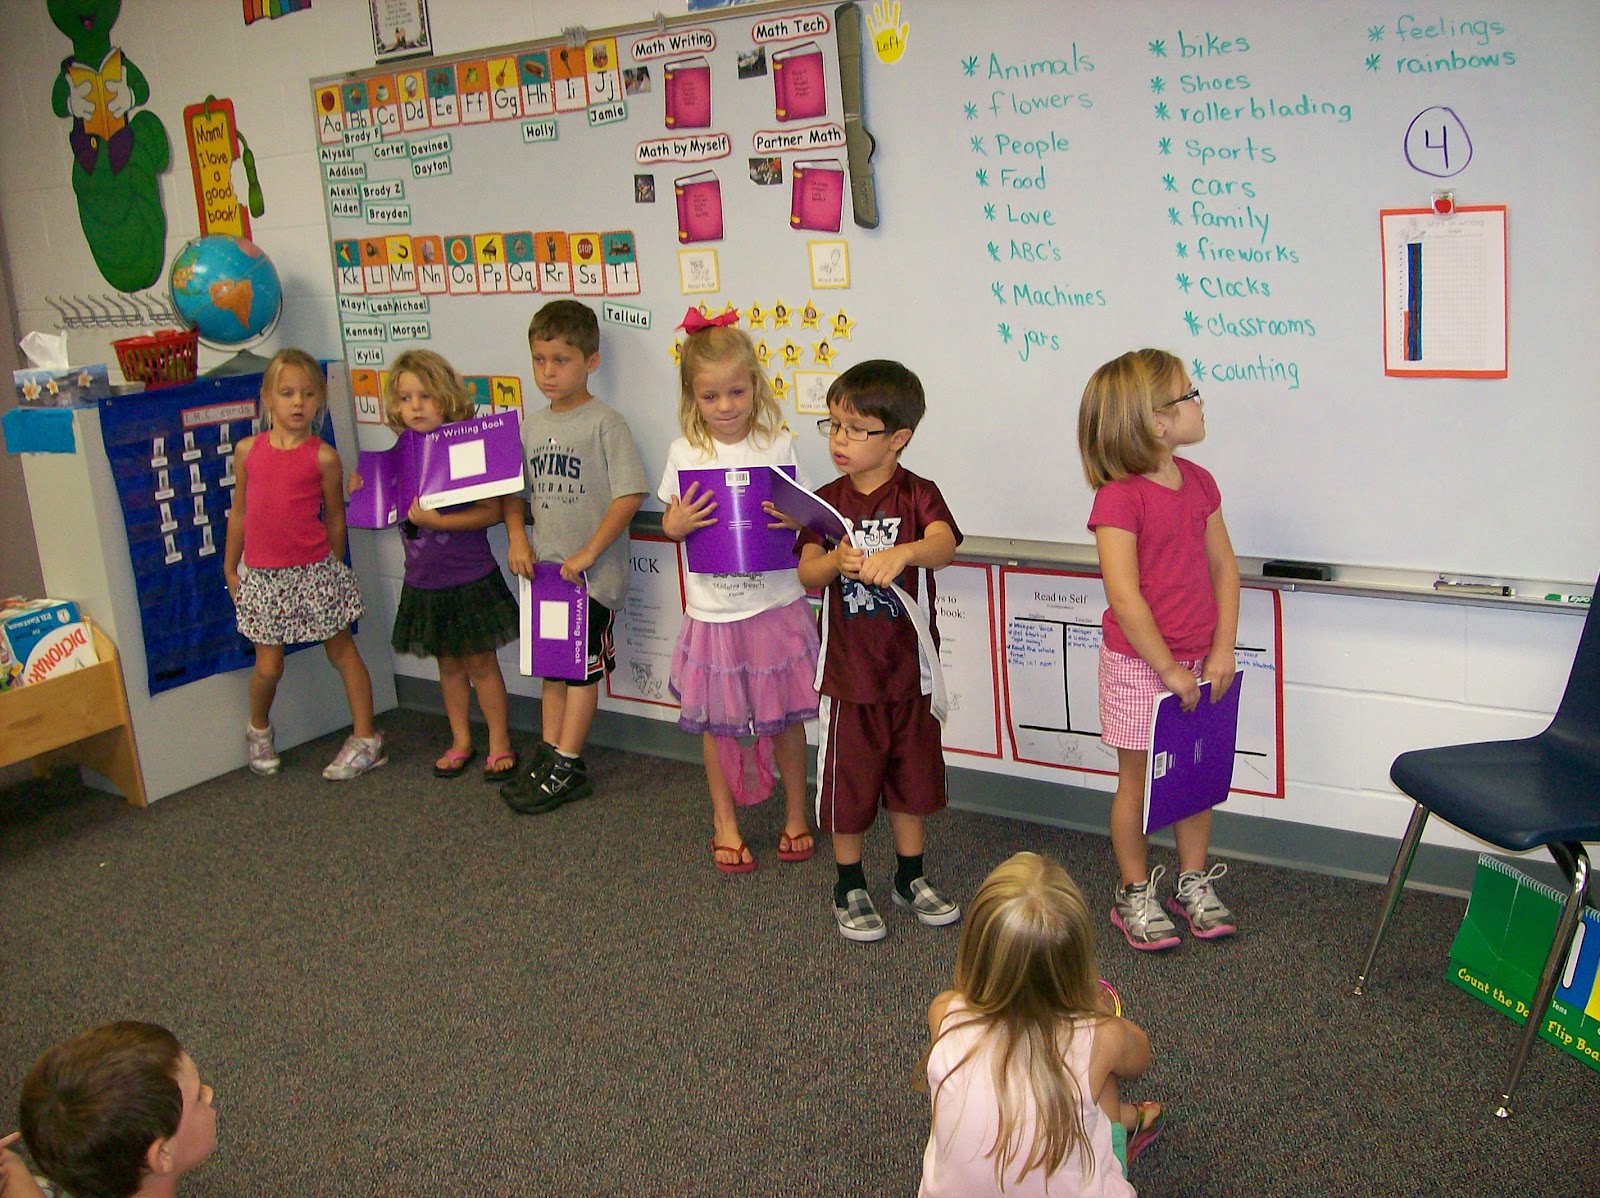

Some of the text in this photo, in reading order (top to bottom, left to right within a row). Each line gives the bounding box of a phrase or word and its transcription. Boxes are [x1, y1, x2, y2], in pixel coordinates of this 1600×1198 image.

[756, 17, 825, 40] Math Tech
[1397, 15, 1505, 46] feelings
[635, 33, 713, 57] Math Writing
[876, 37, 901, 54] Left
[1178, 29, 1250, 59] bikes
[988, 42, 1095, 80] Animals
[1396, 49, 1516, 74] rainbows
[590, 104, 625, 123] Jamie
[989, 90, 1093, 118] flowers
[344, 130, 371, 144] Brody
[526, 125, 555, 140] Holly
[756, 129, 842, 150] Partner Math
[321, 148, 351, 162] Alyssa
[374, 144, 405, 158] Carter
[411, 139, 449, 156] Devinee
[638, 137, 728, 159] Math by Myself
[995, 130, 1070, 160] People
[1424, 124, 1449, 169] 4
[198, 149, 229, 169] I love
[414, 160, 448, 175] Dayton
[213, 170, 221, 183] a
[329, 166, 364, 178] Addison
[1000, 164, 1047, 190] Food
[205, 182, 233, 207] good
[330, 186, 358, 198] Alexis
[363, 185, 392, 198] Brody
[207, 204, 238, 224] book!
[369, 207, 409, 221] Brayden
[1006, 203, 1056, 226] Love
[1191, 200, 1270, 245] family
[578, 243, 593, 255] STOP
[1010, 238, 1062, 263] ABC's
[1197, 236, 1300, 264] fireworks
[1013, 283, 1106, 307] Machines
[371, 301, 392, 312] Leah
[606, 307, 647, 326] Tallula
[345, 324, 427, 338] Kennedy Morgan
[1018, 327, 1060, 362] jars
[357, 349, 380, 362] Kylie
[1212, 354, 1300, 390] counting
[443, 425, 479, 438] Writing
[482, 418, 504, 431] Book
[530, 453, 582, 480] TWINS
[948, 595, 957, 604] to
[1034, 591, 1088, 604] Read to Self
[573, 598, 583, 638] Writing
[940, 606, 966, 619] book:
[574, 639, 583, 665] Book
[1457, 967, 1600, 1063] Count the Da Flip Boa
[1552, 1000, 1568, 1015] Tens
